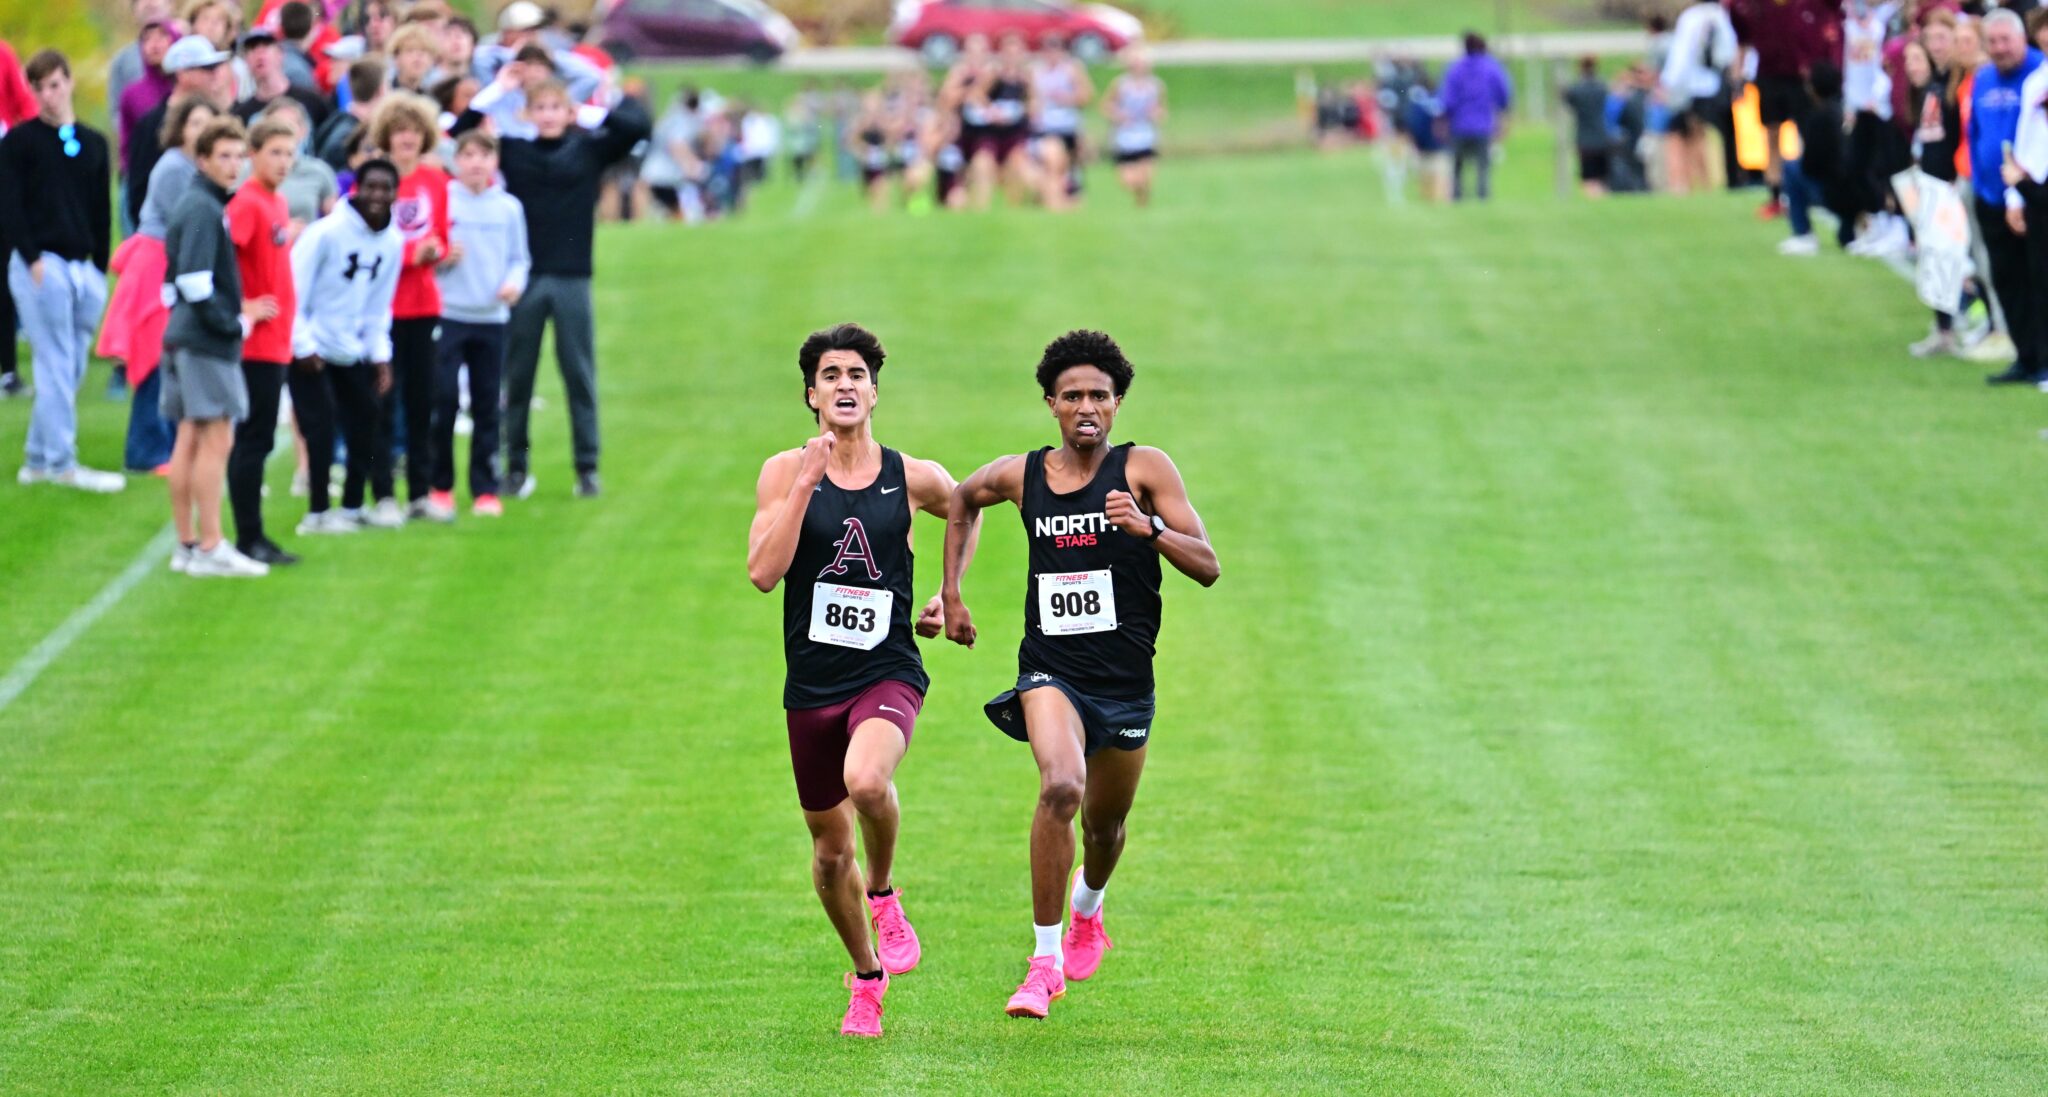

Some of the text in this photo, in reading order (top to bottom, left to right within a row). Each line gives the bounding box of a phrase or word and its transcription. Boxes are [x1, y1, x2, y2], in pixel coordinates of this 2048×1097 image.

[1036, 512, 1117, 537] NORTH
[817, 517, 882, 580] A
[1055, 534, 1097, 549] STARS
[835, 587, 871, 597] FITNESS
[1051, 590, 1101, 617] 908
[825, 603, 876, 633] 863
[1119, 728, 1146, 738] HOKA
